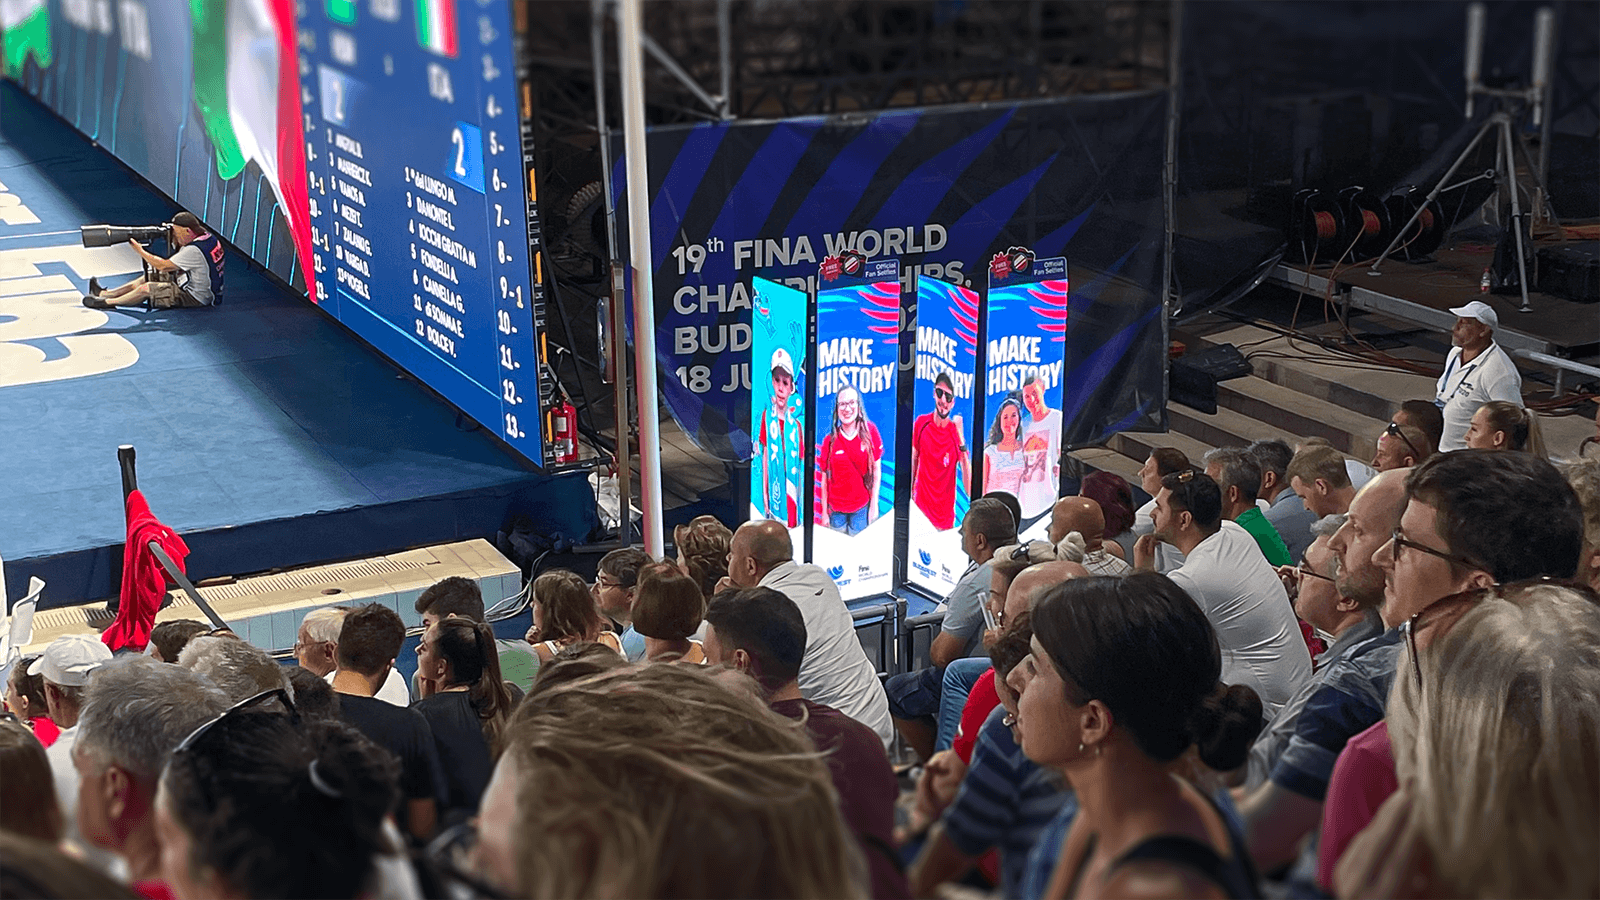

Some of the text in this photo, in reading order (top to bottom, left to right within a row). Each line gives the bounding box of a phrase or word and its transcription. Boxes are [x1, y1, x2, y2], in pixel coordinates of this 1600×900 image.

[452, 127, 466, 177] 2
[331, 175, 337, 191] 5
[404, 166, 411, 183] 1
[406, 191, 413, 209] 3
[408, 218, 415, 235] 4
[410, 243, 417, 260] 5
[672, 223, 948, 275] 19th FINA WORLD
[412, 269, 419, 285] 6
[413, 293, 423, 312] 11
[415, 318, 425, 337] 12
[819, 337, 874, 369] MAKE
[918, 326, 958, 367] MAKE
[989, 335, 1041, 368] MAKE
[819, 362, 895, 398] HISTORY
